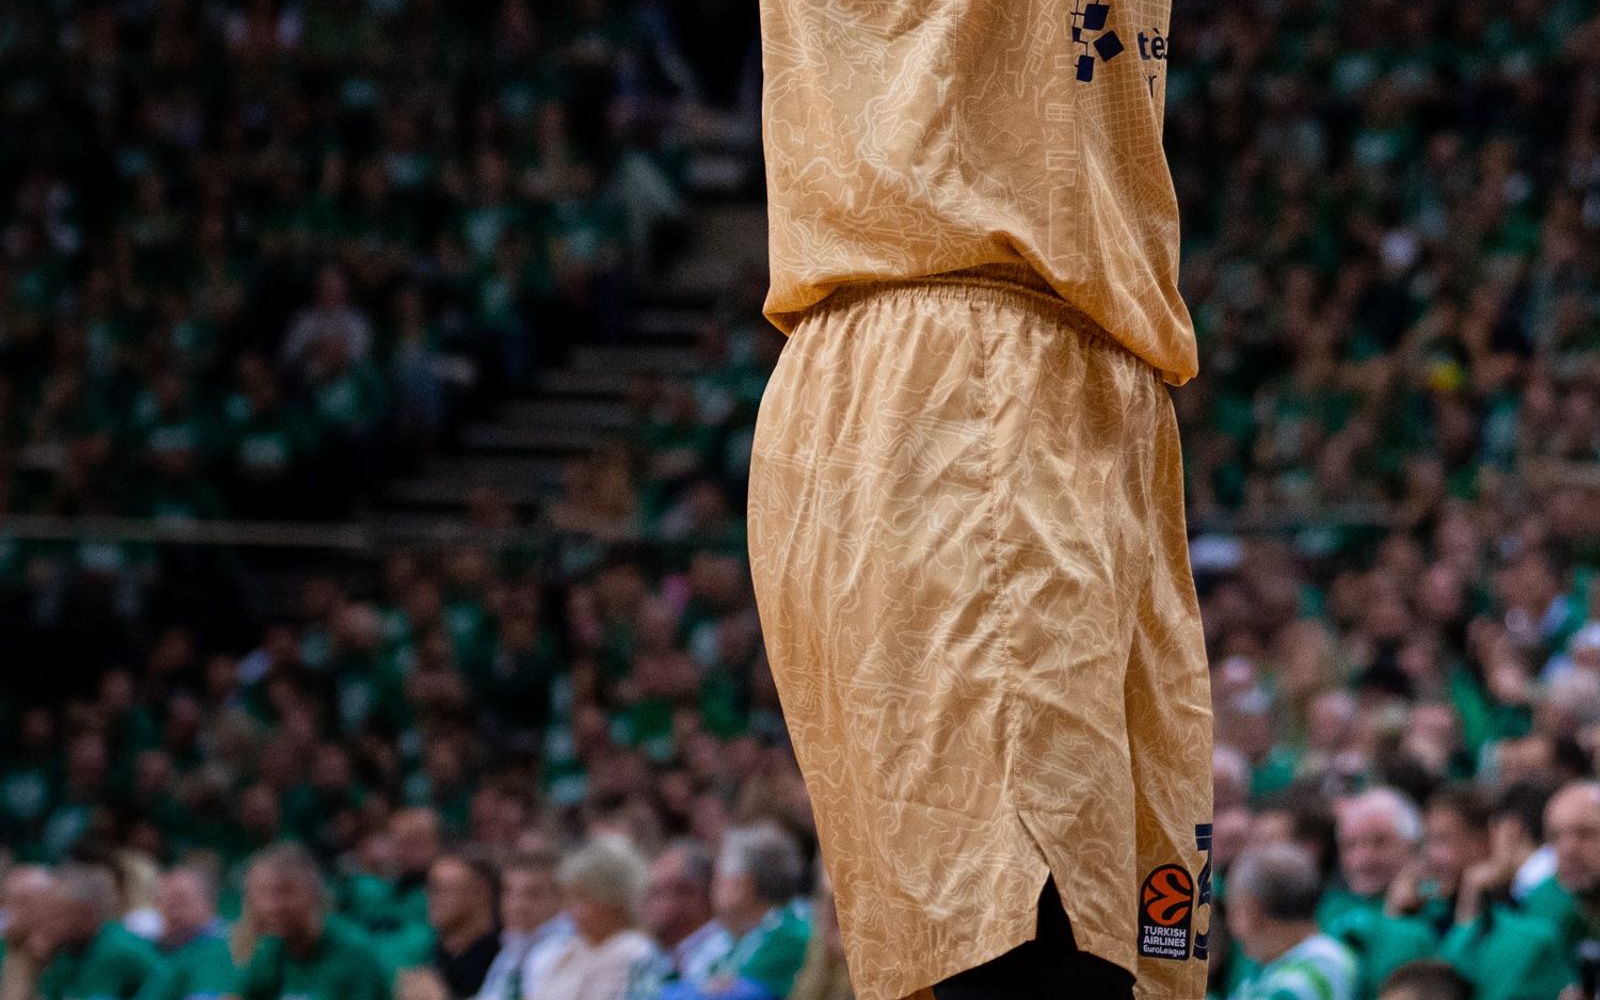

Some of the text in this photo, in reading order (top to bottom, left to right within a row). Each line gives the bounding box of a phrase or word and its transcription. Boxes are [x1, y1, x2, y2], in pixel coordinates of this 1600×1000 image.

[1143, 925, 1186, 938] TURKISH
[1143, 935, 1186, 948] AIRLINES
[1143, 944, 1186, 957] EuroLeague
